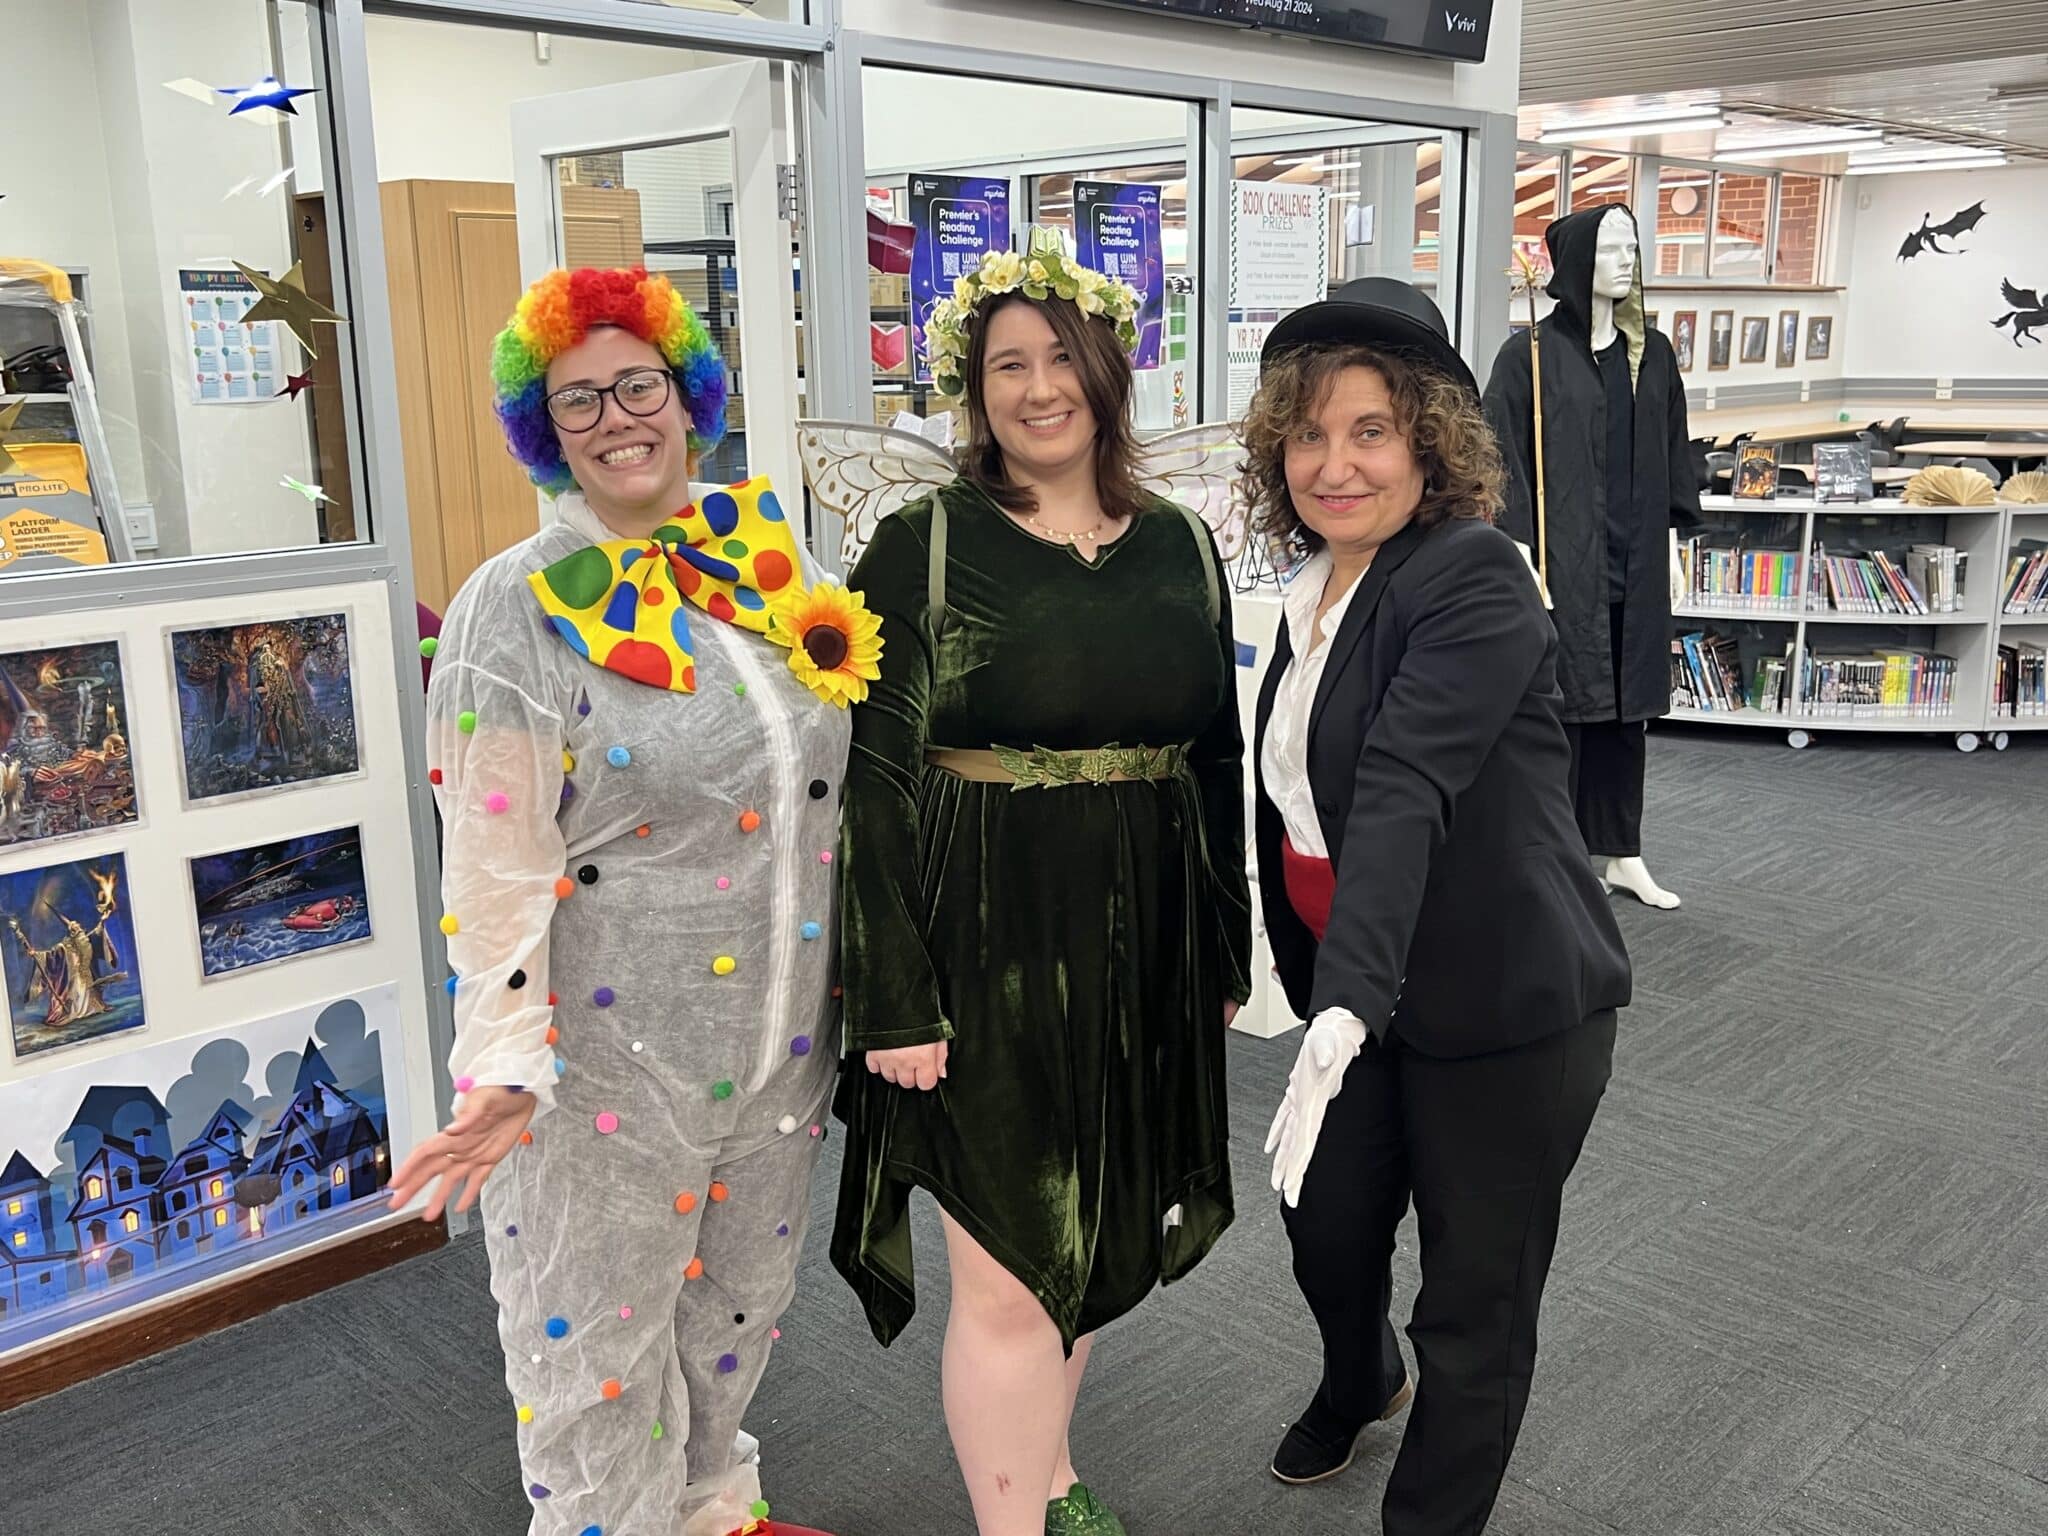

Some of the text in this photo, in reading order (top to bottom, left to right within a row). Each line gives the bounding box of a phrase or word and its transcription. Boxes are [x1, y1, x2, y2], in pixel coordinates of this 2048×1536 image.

[1264, 0, 1282, 12] Aug
[1283, 0, 1292, 11] 21
[1293, 1, 1313, 15] 2024
[1457, 17, 1477, 32] vivi
[1243, 191, 1312, 217] BOOK CHALLENGE
[939, 208, 980, 220] Premier's
[1099, 213, 1136, 224] Premier's
[940, 221, 976, 234] Reading
[1262, 215, 1293, 231] PRIZES
[1100, 224, 1132, 237] Reading
[940, 234, 984, 247] Challenge
[1100, 236, 1140, 248] Challenge
[962, 252, 980, 264] WIN
[1120, 253, 1137, 265] WIN
[1237, 328, 1263, 349] YR 7-8
[9, 518, 60, 528] PLATFORM
[11, 526, 50, 536] LADDER
